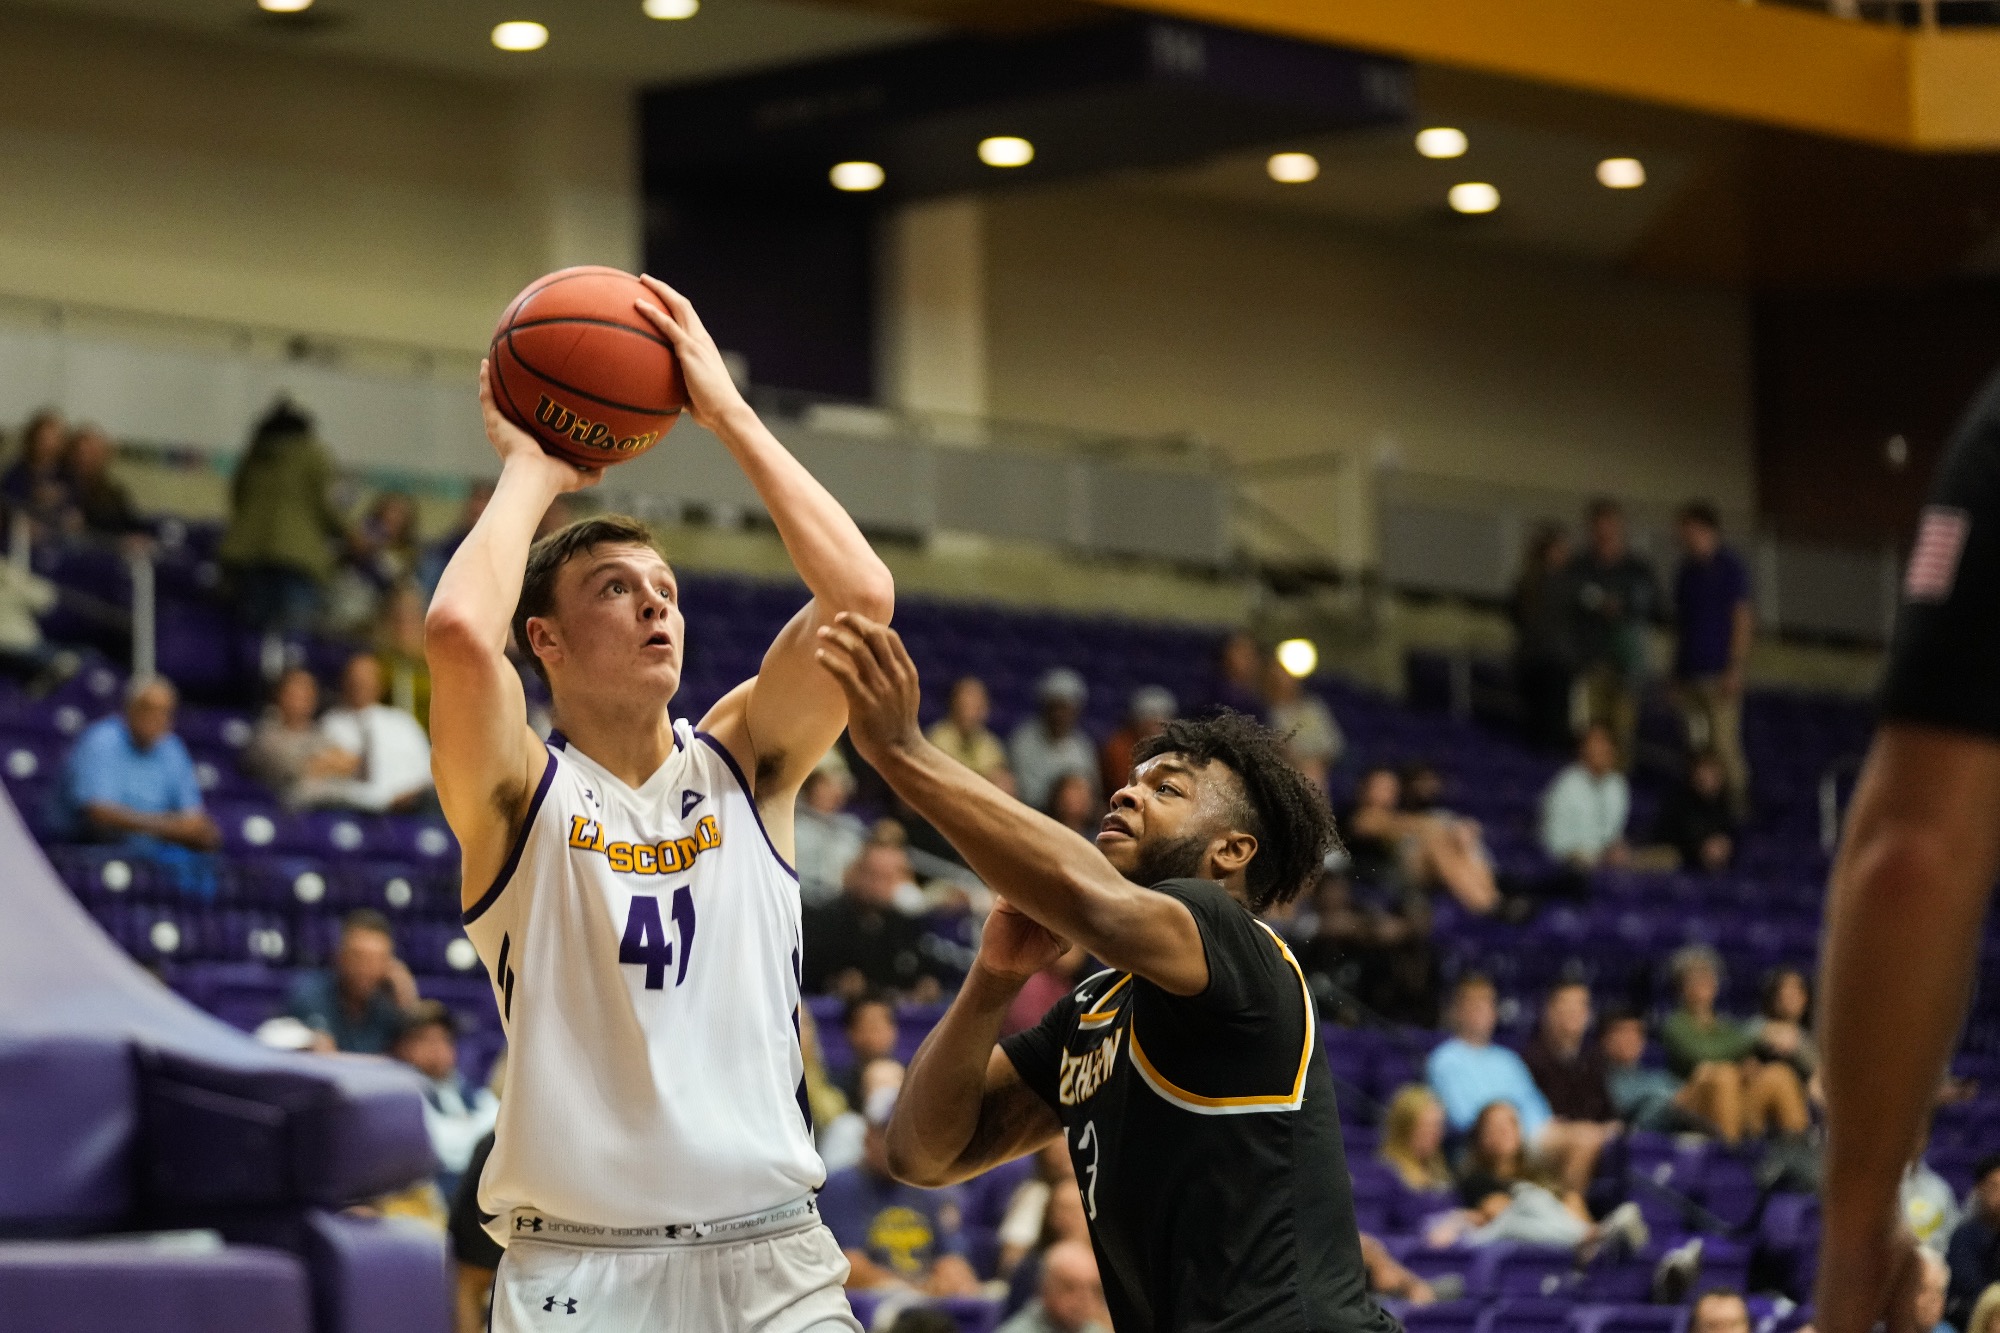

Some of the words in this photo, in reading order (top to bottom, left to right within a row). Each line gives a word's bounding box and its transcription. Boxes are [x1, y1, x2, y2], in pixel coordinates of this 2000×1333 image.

[534, 392, 659, 451] Wilson
[569, 814, 722, 875] LISCOMB
[619, 884, 696, 990] 41
[771, 1206, 805, 1222] UNDER
[548, 1222, 605, 1236] ARMOUR
[611, 1227, 659, 1237] UNDER
[713, 1216, 766, 1233] ARMOUR
